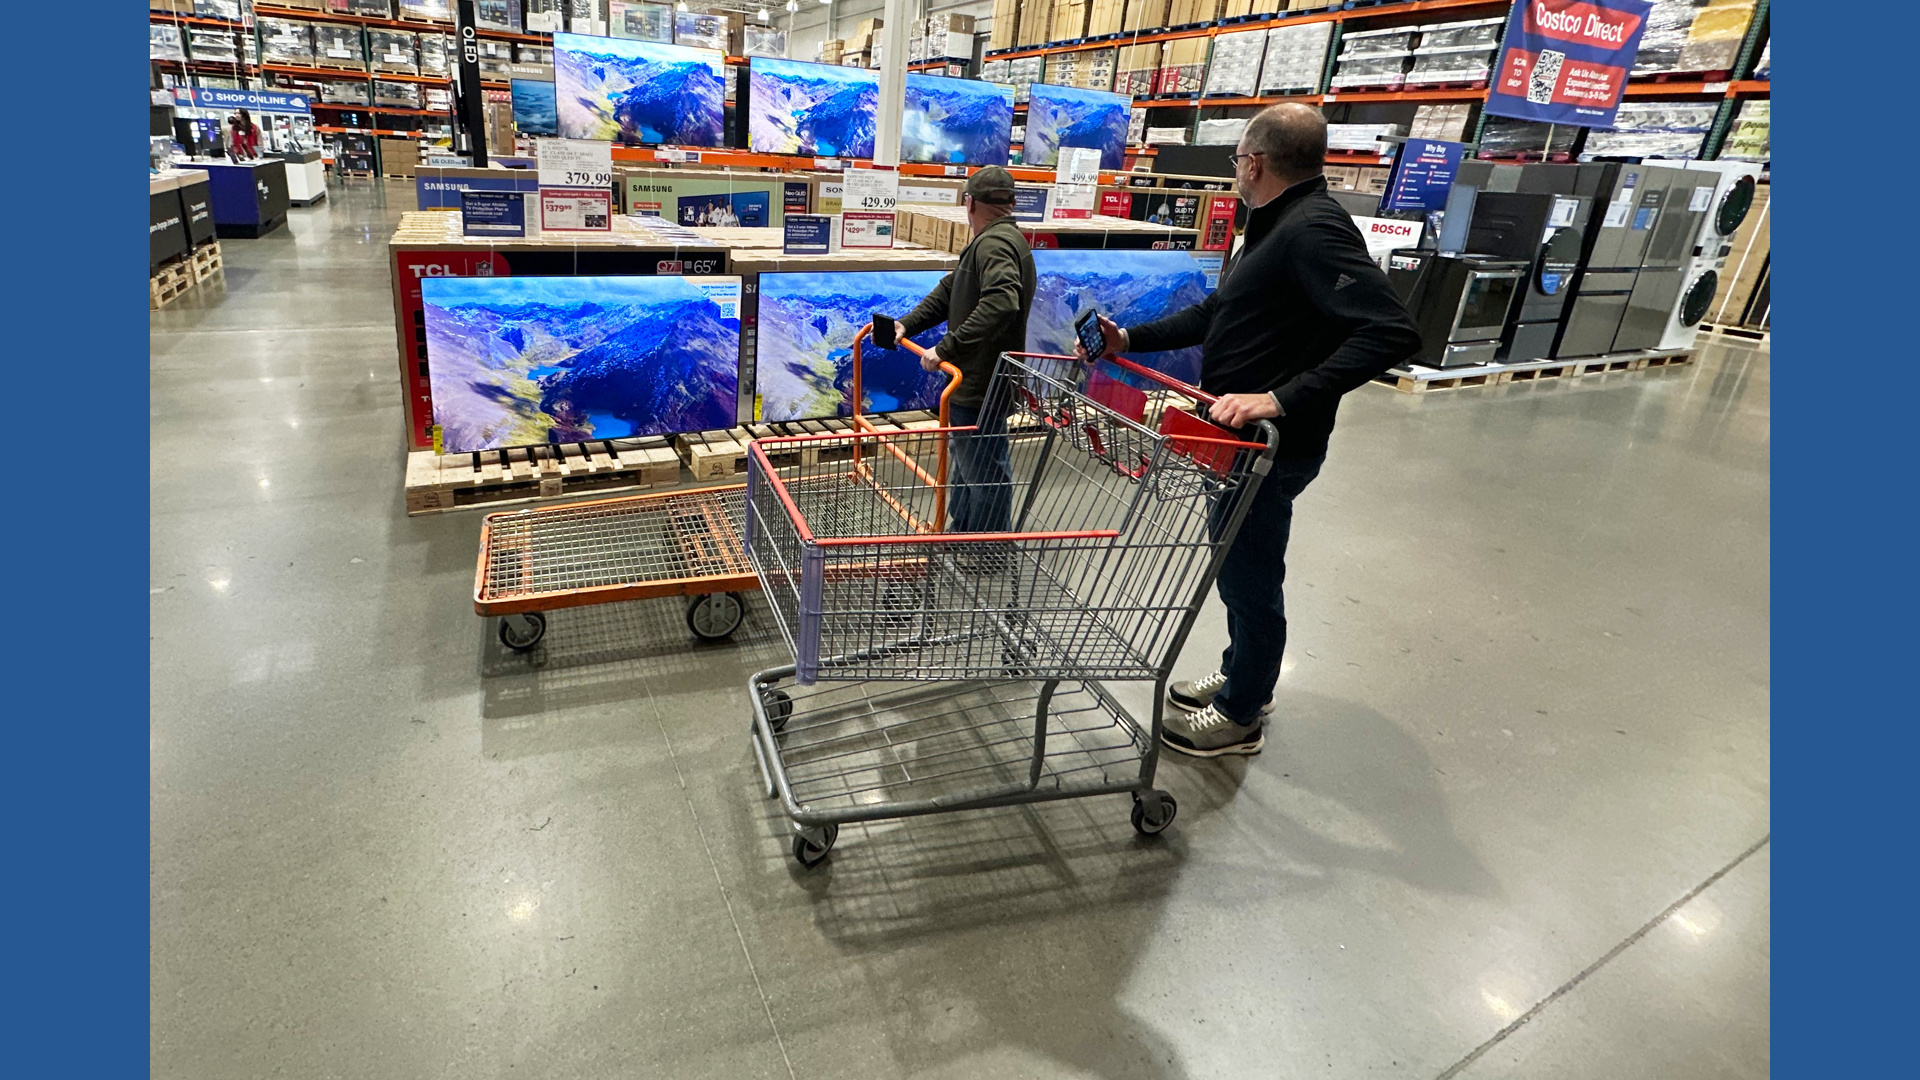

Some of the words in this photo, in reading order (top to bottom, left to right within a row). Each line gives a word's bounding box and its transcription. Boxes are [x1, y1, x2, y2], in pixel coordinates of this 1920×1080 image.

[1536, 2, 1582, 34] Costco
[1583, 13, 1624, 43] Direct
[462, 26, 478, 64] OLED
[512, 66, 544, 75] SAMSUNG
[1513, 68, 1522, 77] TO
[1507, 78, 1522, 88] SHOP
[216, 93, 246, 102] SHOP
[248, 95, 287, 105] ONLINE
[1425, 143, 1436, 153] Why
[1436, 144, 1447, 154] Buy
[565, 171, 611, 186] 379.99
[1071, 172, 1098, 182] 499.99
[424, 182, 470, 191] SAMSUNG
[632, 184, 673, 193] SAMSUNG
[825, 186, 844, 194] SON
[861, 196, 896, 208] 429.99
[1105, 195, 1118, 203] TCL
[1371, 223, 1412, 237] BOSCH
[408, 263, 458, 279] TCL
[693, 260, 717, 274] 65"
